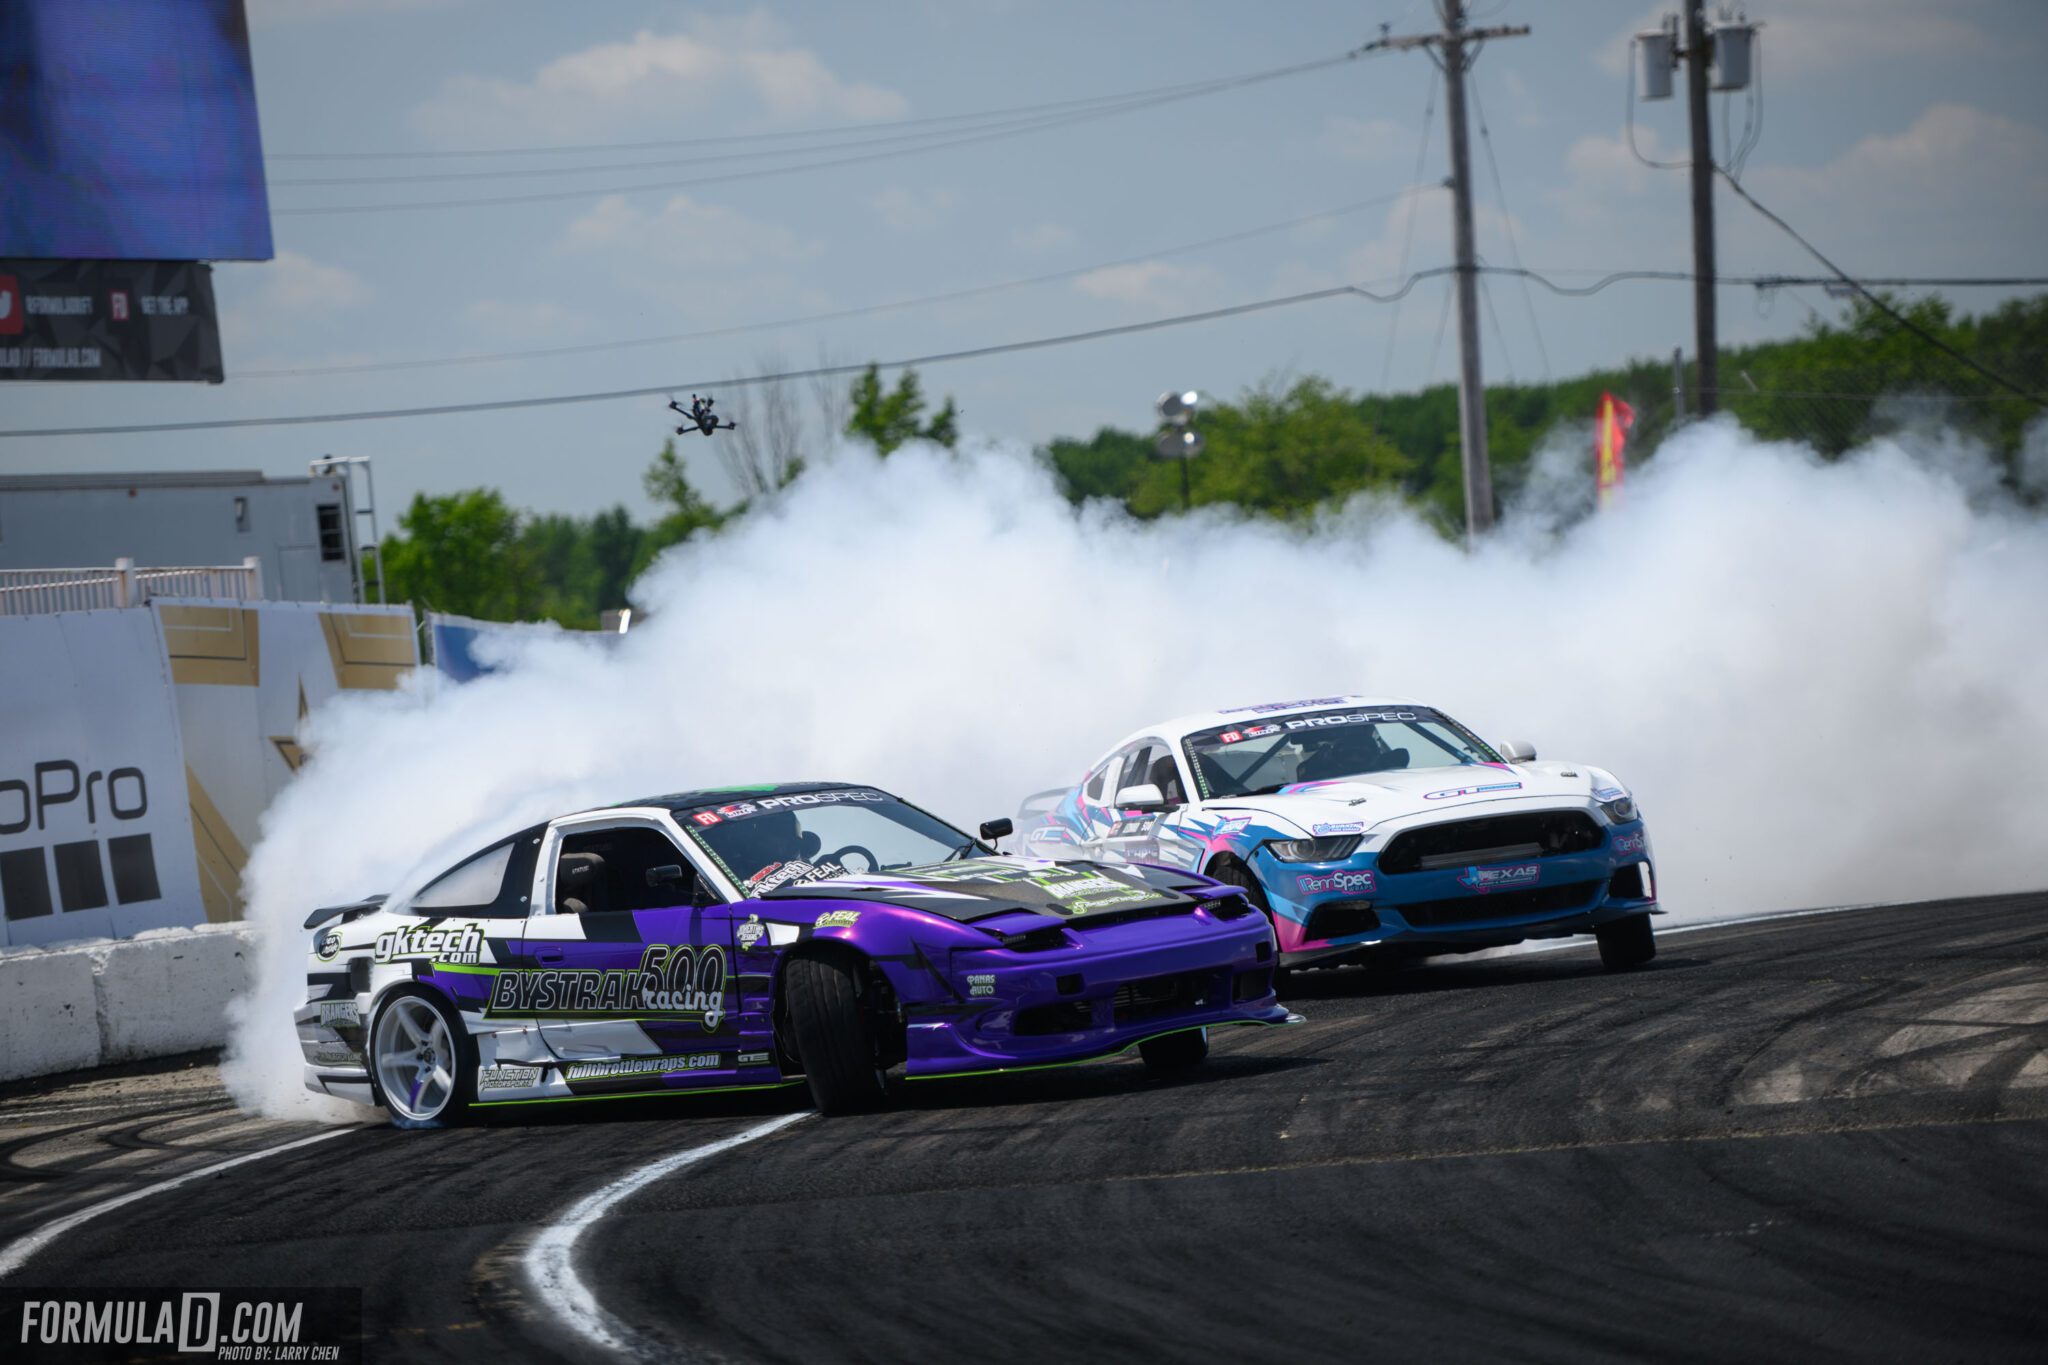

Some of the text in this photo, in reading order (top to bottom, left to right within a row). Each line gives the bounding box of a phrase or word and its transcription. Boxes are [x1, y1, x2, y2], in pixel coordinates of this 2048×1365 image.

[1286, 712, 1416, 729] PROSPEC
[1222, 731, 1240, 743] FD
[0, 760, 148, 835] oPro
[757, 793, 883, 809] PROSPEC
[696, 813, 719, 825] FD
[805, 862, 841, 881] FEAL
[1301, 872, 1371, 891] RennSpec
[376, 923, 480, 963] gktech
[431, 951, 478, 964] .com
[643, 945, 725, 994] 500
[643, 983, 723, 1028] racing
[481, 1068, 539, 1081] FUNCTION
